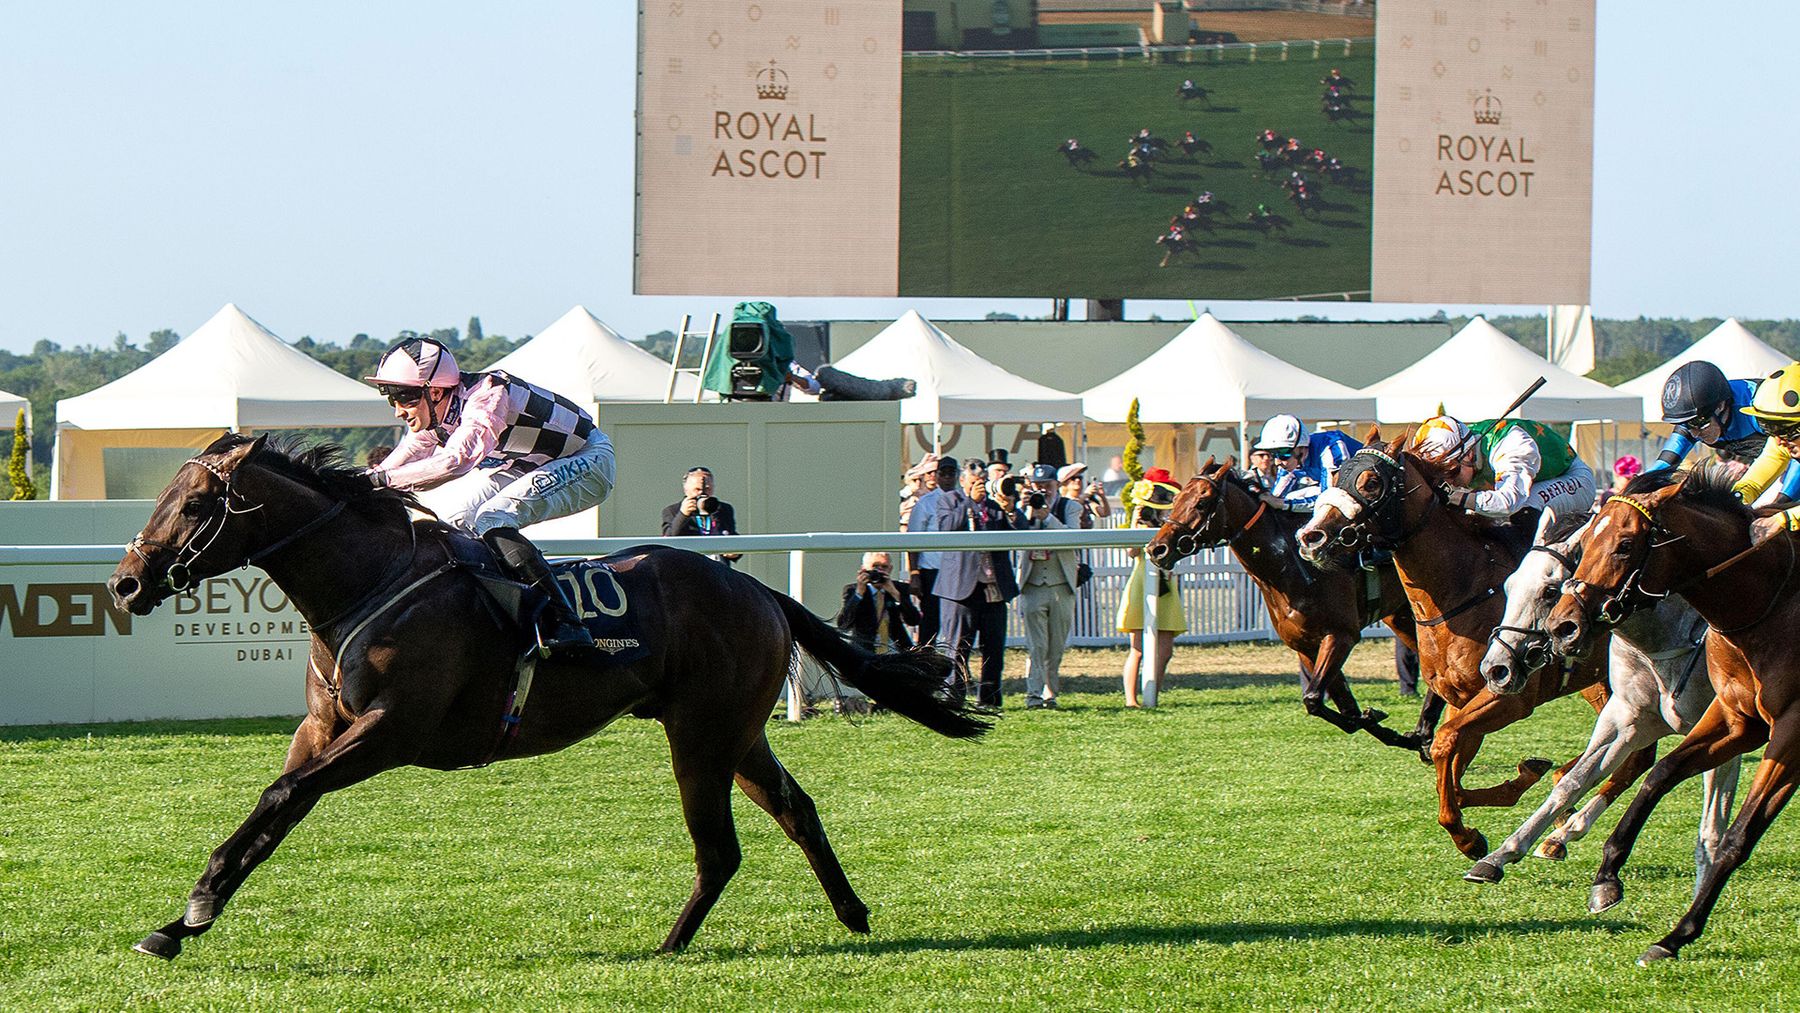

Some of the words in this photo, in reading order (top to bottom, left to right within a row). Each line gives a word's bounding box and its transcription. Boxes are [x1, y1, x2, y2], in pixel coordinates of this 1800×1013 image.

[714, 111, 827, 142] ROYAL
[1437, 134, 1535, 163] ROYAL
[711, 149, 827, 179] ASCOT
[1435, 170, 1535, 197] ASCOT
[175, 577, 297, 615] BEYO
[557, 567, 628, 619] 10
[0, 582, 133, 637] WDEN
[175, 621, 308, 637] DEVELOPME
[594, 638, 640, 648] ONGINES
[237, 648, 292, 661] DUBAI
